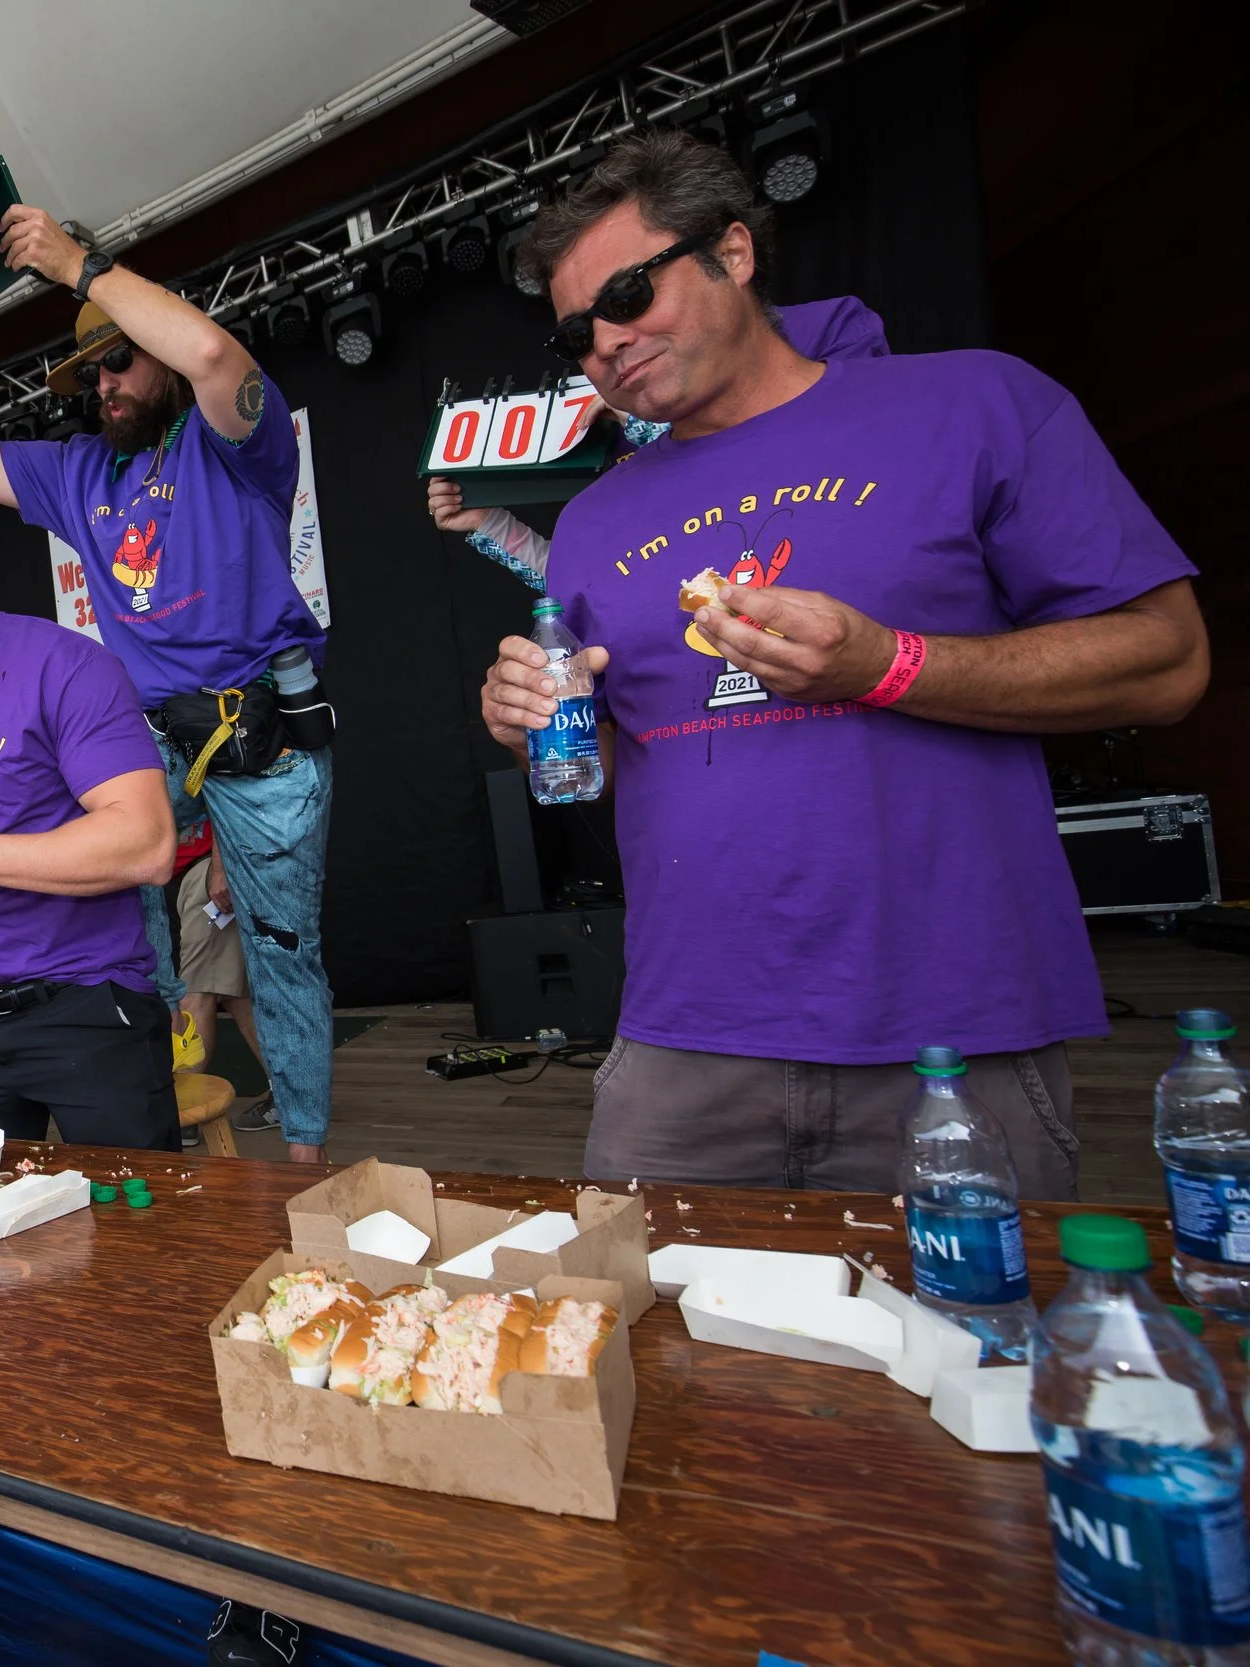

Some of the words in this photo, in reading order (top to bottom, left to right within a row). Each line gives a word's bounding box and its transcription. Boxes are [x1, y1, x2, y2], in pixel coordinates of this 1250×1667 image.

[442, 393, 598, 463] 007
[149, 483, 175, 501] oll
[615, 534, 669, 577] I'm
[682, 506, 724, 535] on
[738, 494, 758, 514] a
[773, 477, 846, 506] roll
[298, 554, 315, 576] MUSIC
[74, 595, 97, 627] 32
[910, 634, 923, 667] PTON
[718, 675, 754, 692] 2021
[554, 705, 596, 732] DASA
[638, 725, 679, 744] MPTON
[682, 716, 727, 735] BEACH
[732, 707, 805, 728] SEAFOOD
[910, 1226, 966, 1262] ANI
[1050, 1492, 1143, 1571] ANI
